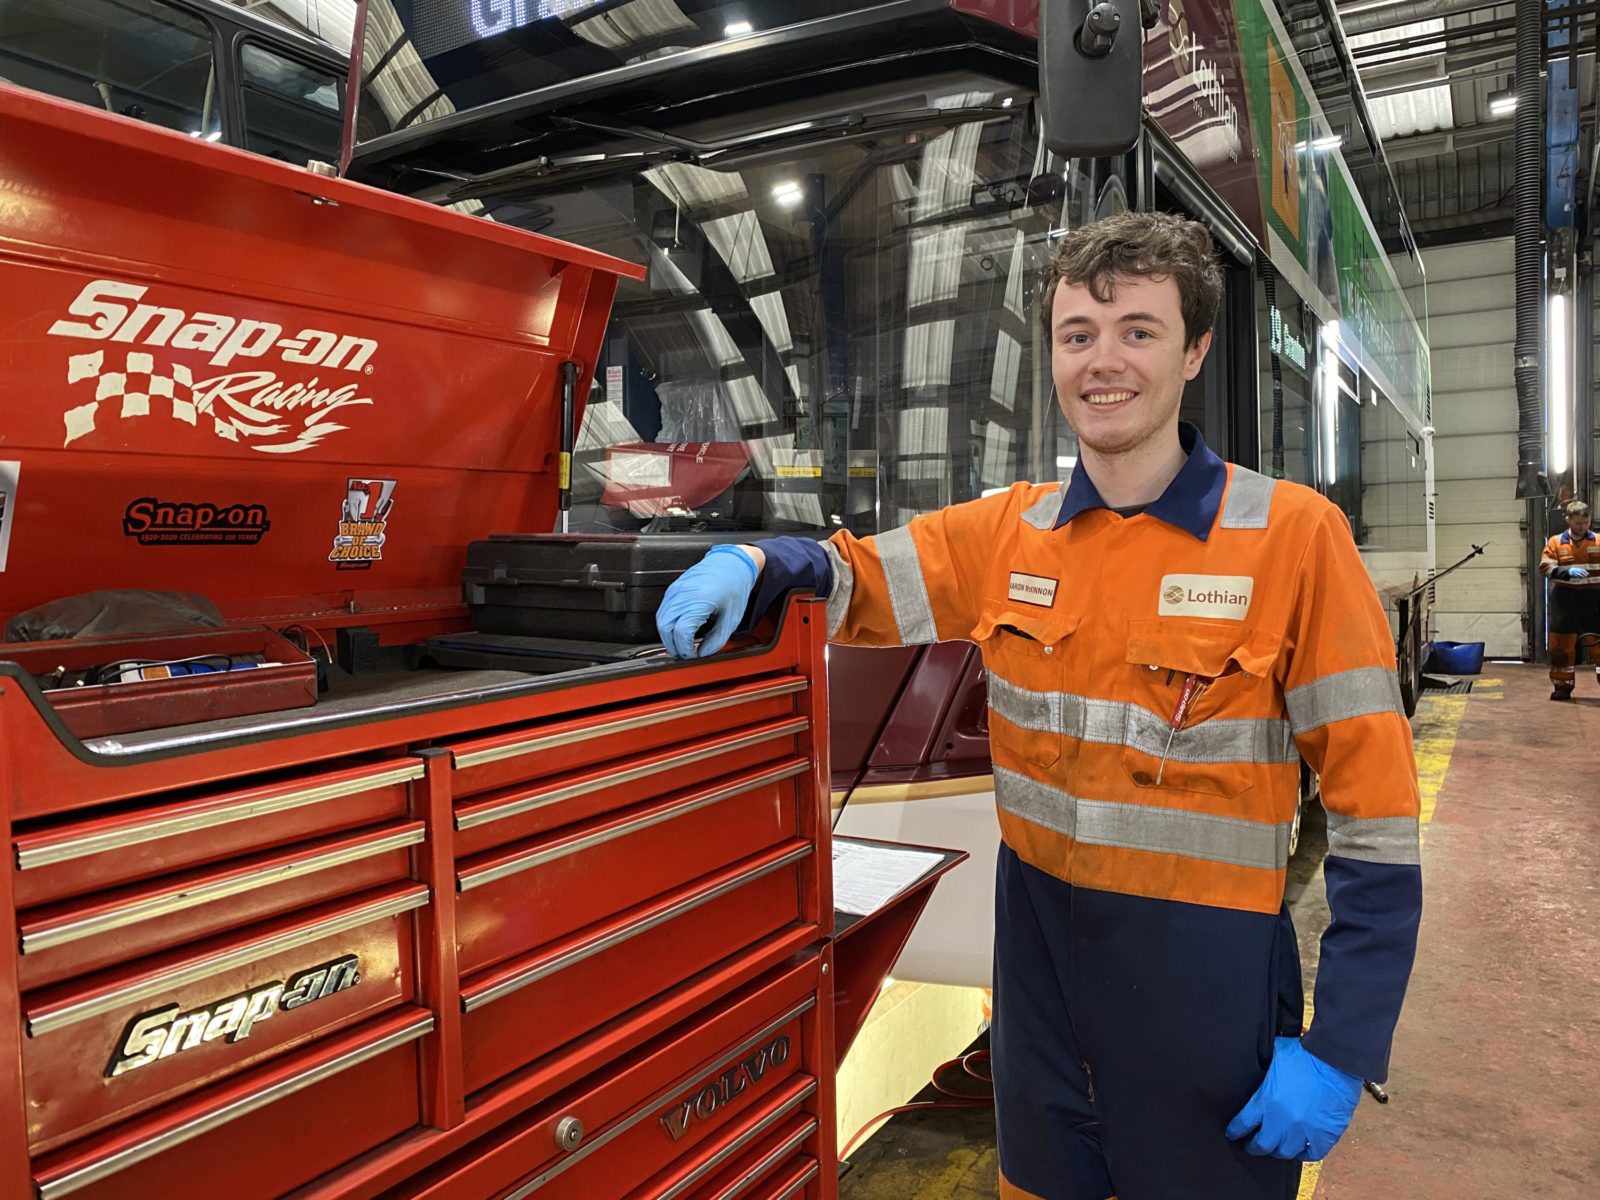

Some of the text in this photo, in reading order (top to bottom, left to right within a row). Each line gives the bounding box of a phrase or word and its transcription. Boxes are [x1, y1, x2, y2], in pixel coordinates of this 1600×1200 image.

[47, 279, 379, 372] Snap-on
[191, 371, 374, 427] Racing
[360, 481, 384, 519] 1
[127, 502, 263, 533] Snap-on
[340, 522, 385, 536] BRAND
[238, 533, 258, 541] YEARS
[330, 545, 381, 560] CHOICE
[352, 536, 366, 546] OF
[1187, 588, 1248, 607] Lothian
[108, 956, 361, 1078] Snap-on
[659, 1034, 792, 1141] VOLVO
